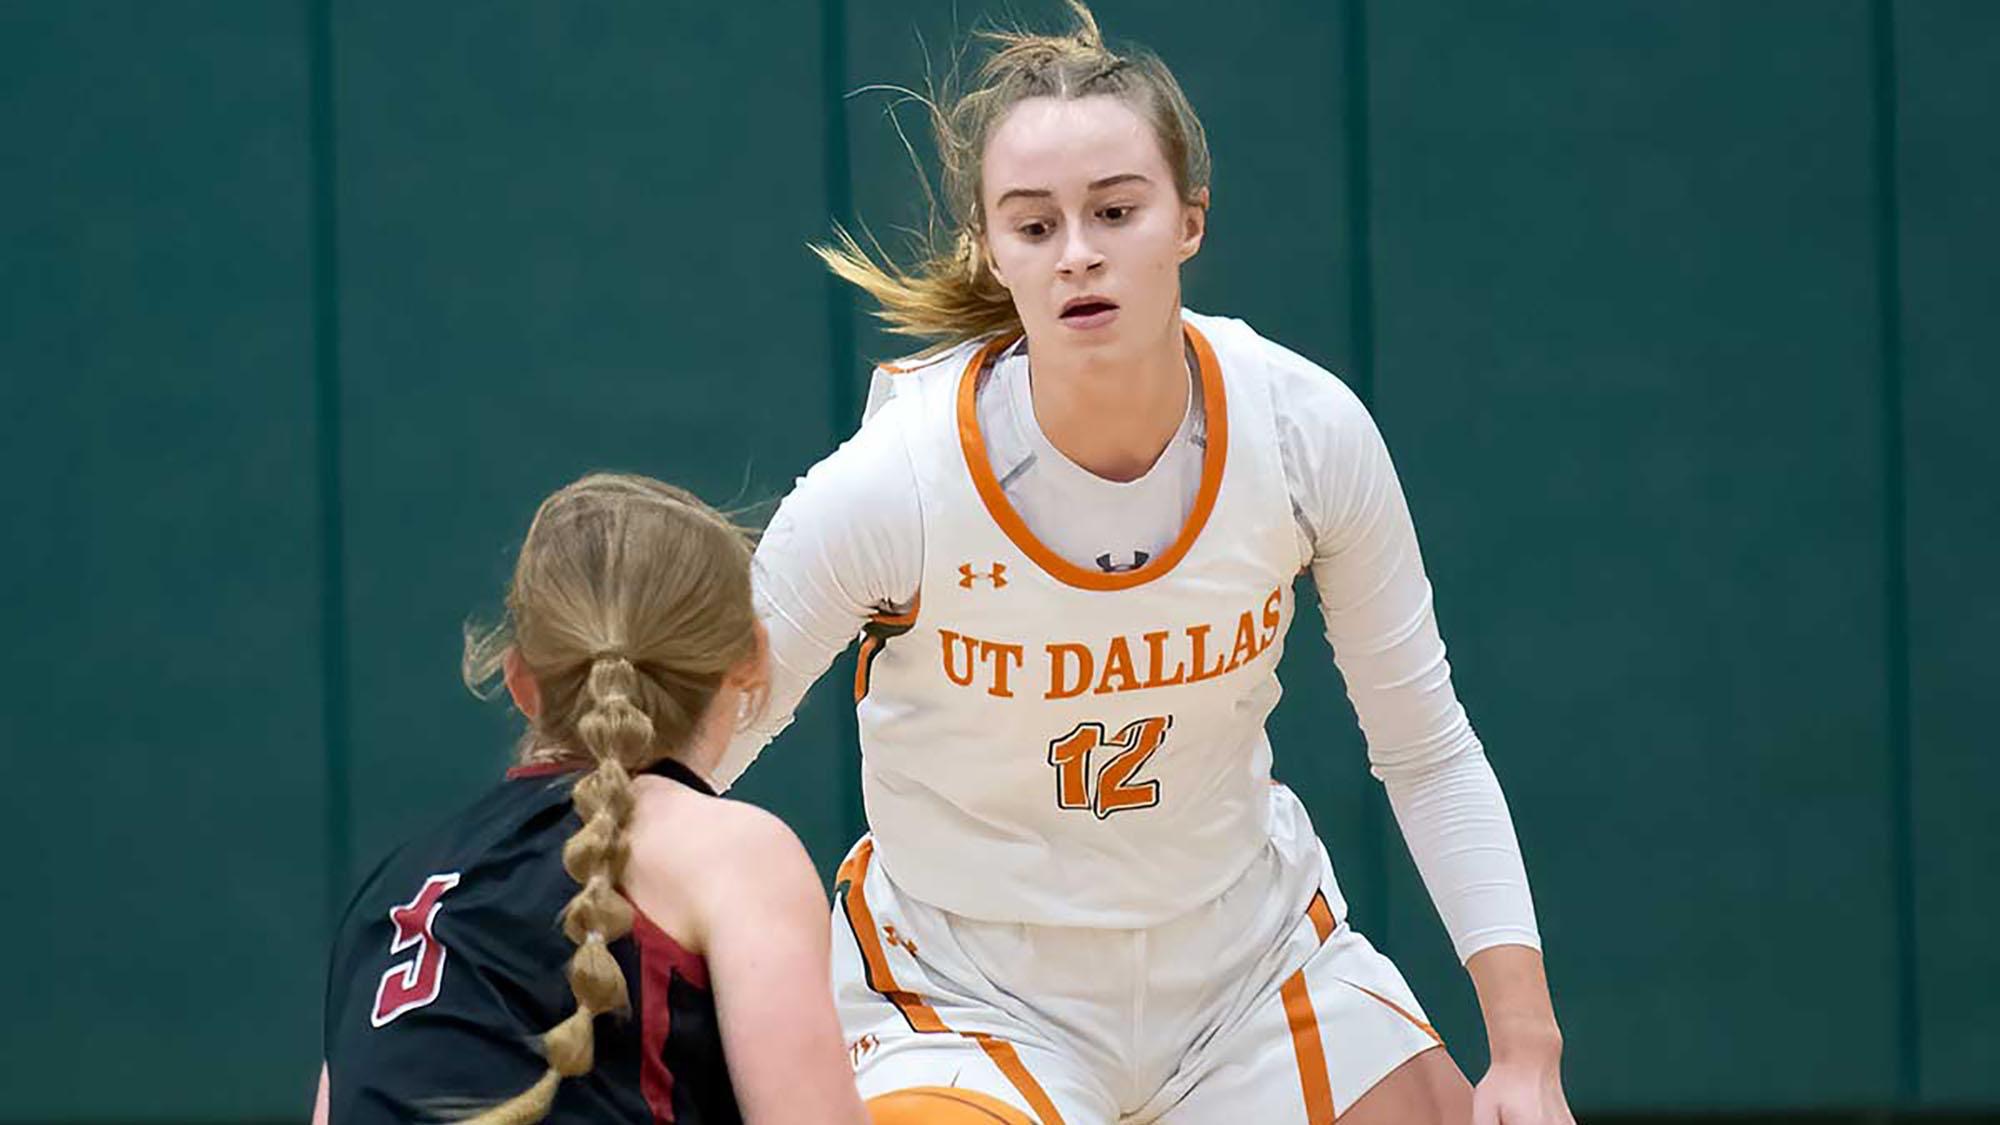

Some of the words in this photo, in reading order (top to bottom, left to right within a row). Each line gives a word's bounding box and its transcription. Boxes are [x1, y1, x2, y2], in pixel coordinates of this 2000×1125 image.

[938, 628, 1024, 698] UT
[1044, 586, 1282, 700] DALLAS
[1048, 715, 1173, 820] 12
